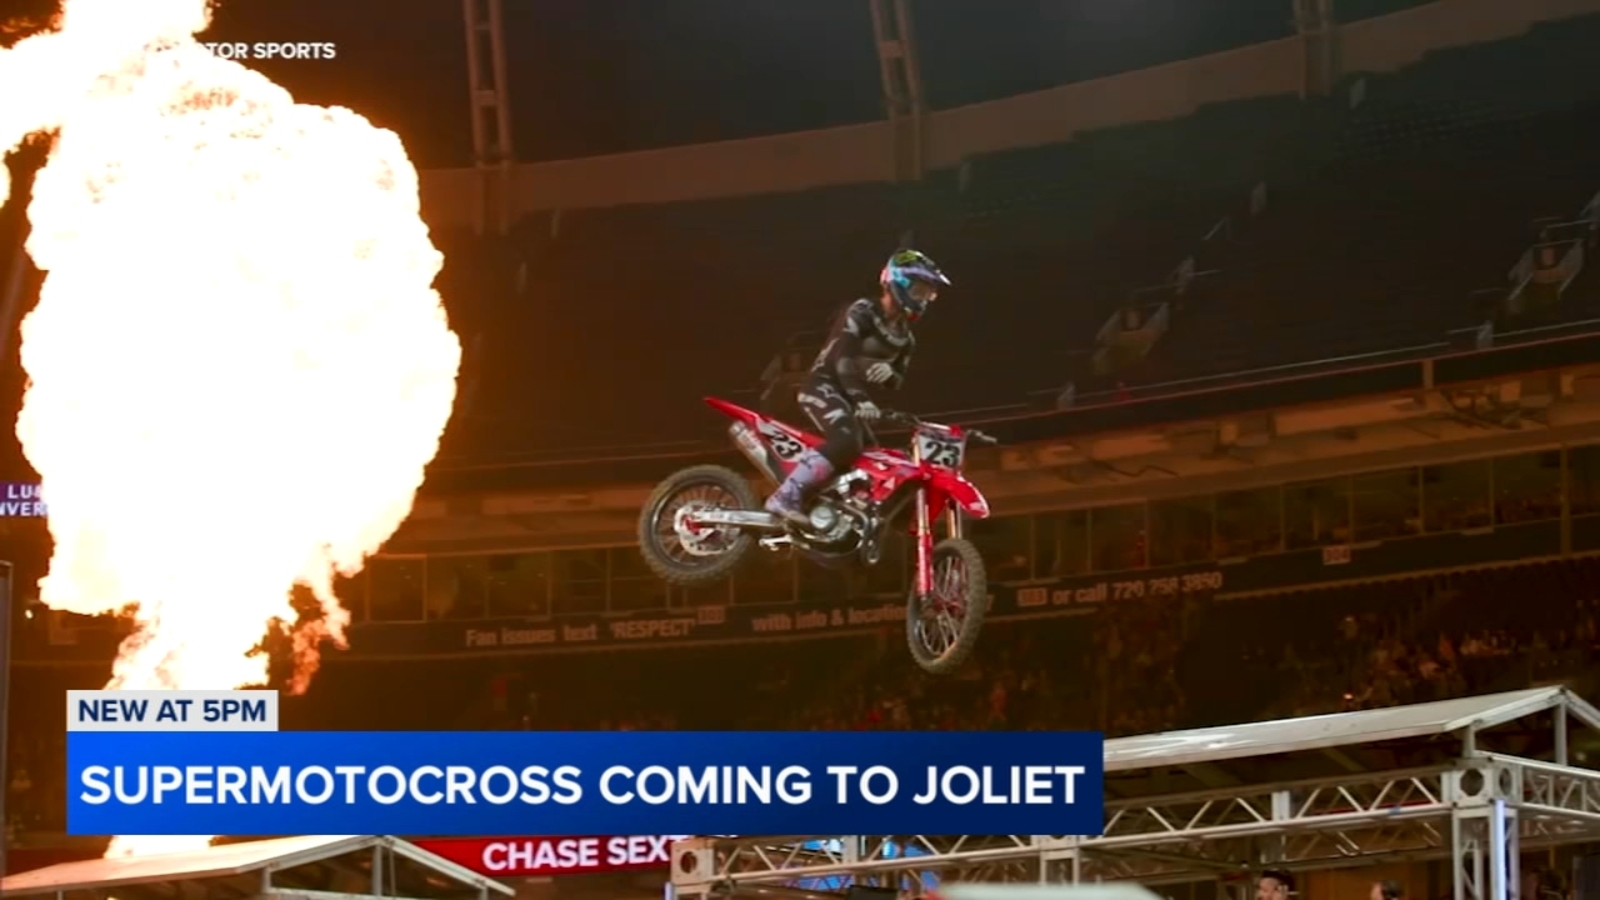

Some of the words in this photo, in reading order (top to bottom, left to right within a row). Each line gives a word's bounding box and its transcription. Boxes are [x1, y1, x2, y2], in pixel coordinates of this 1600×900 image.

[768, 431, 803, 459] 23
[925, 441, 960, 468] 23
[1052, 589, 1069, 605] or
[1075, 582, 1107, 603] call
[1112, 580, 1144, 600] 720
[466, 629, 497, 647] Fan
[501, 627, 555, 645] issues
[563, 624, 597, 641] text
[752, 613, 791, 631] with
[795, 610, 827, 630] info
[830, 608, 844, 626] &
[482, 838, 599, 870] CHASE
[606, 835, 689, 865] SEX
